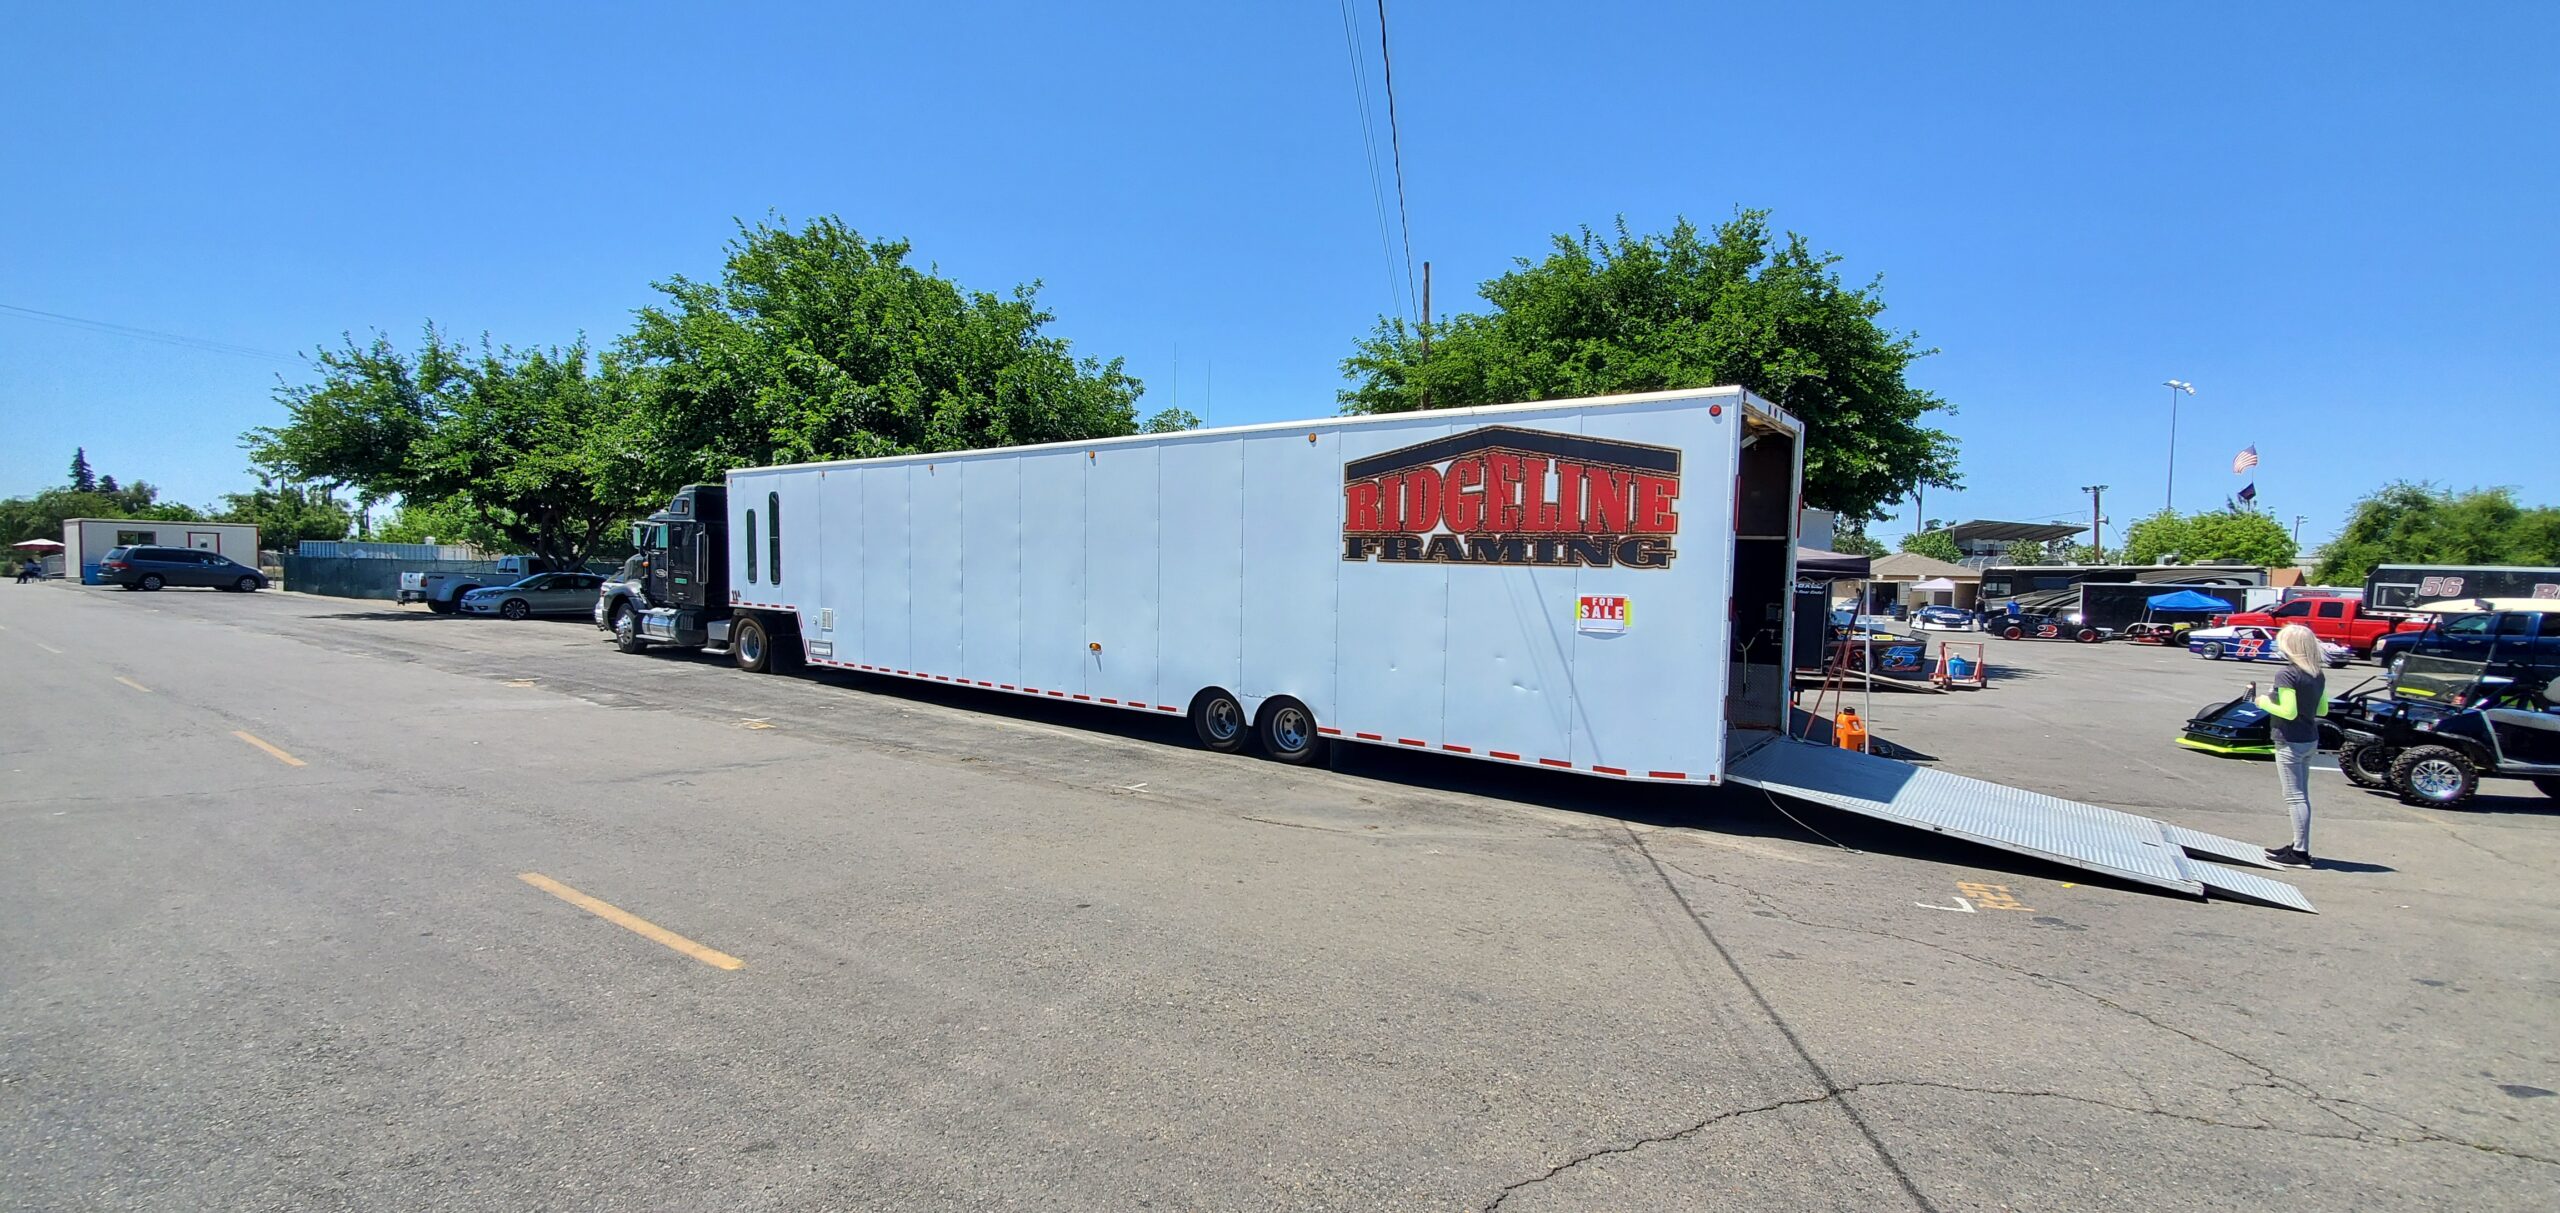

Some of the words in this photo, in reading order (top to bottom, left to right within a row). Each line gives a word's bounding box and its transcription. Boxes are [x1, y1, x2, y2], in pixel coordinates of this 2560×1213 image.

[1343, 451, 1679, 534] RIDGELINE
[1342, 533, 1677, 568] FRAMING
[2419, 576, 2464, 598] 56
[1580, 604, 1624, 620] SALE
[1591, 597, 1614, 607] FOR
[2036, 624, 2058, 638] 2
[1882, 645, 1923, 667] 5
[2236, 639, 2264, 657] 77
